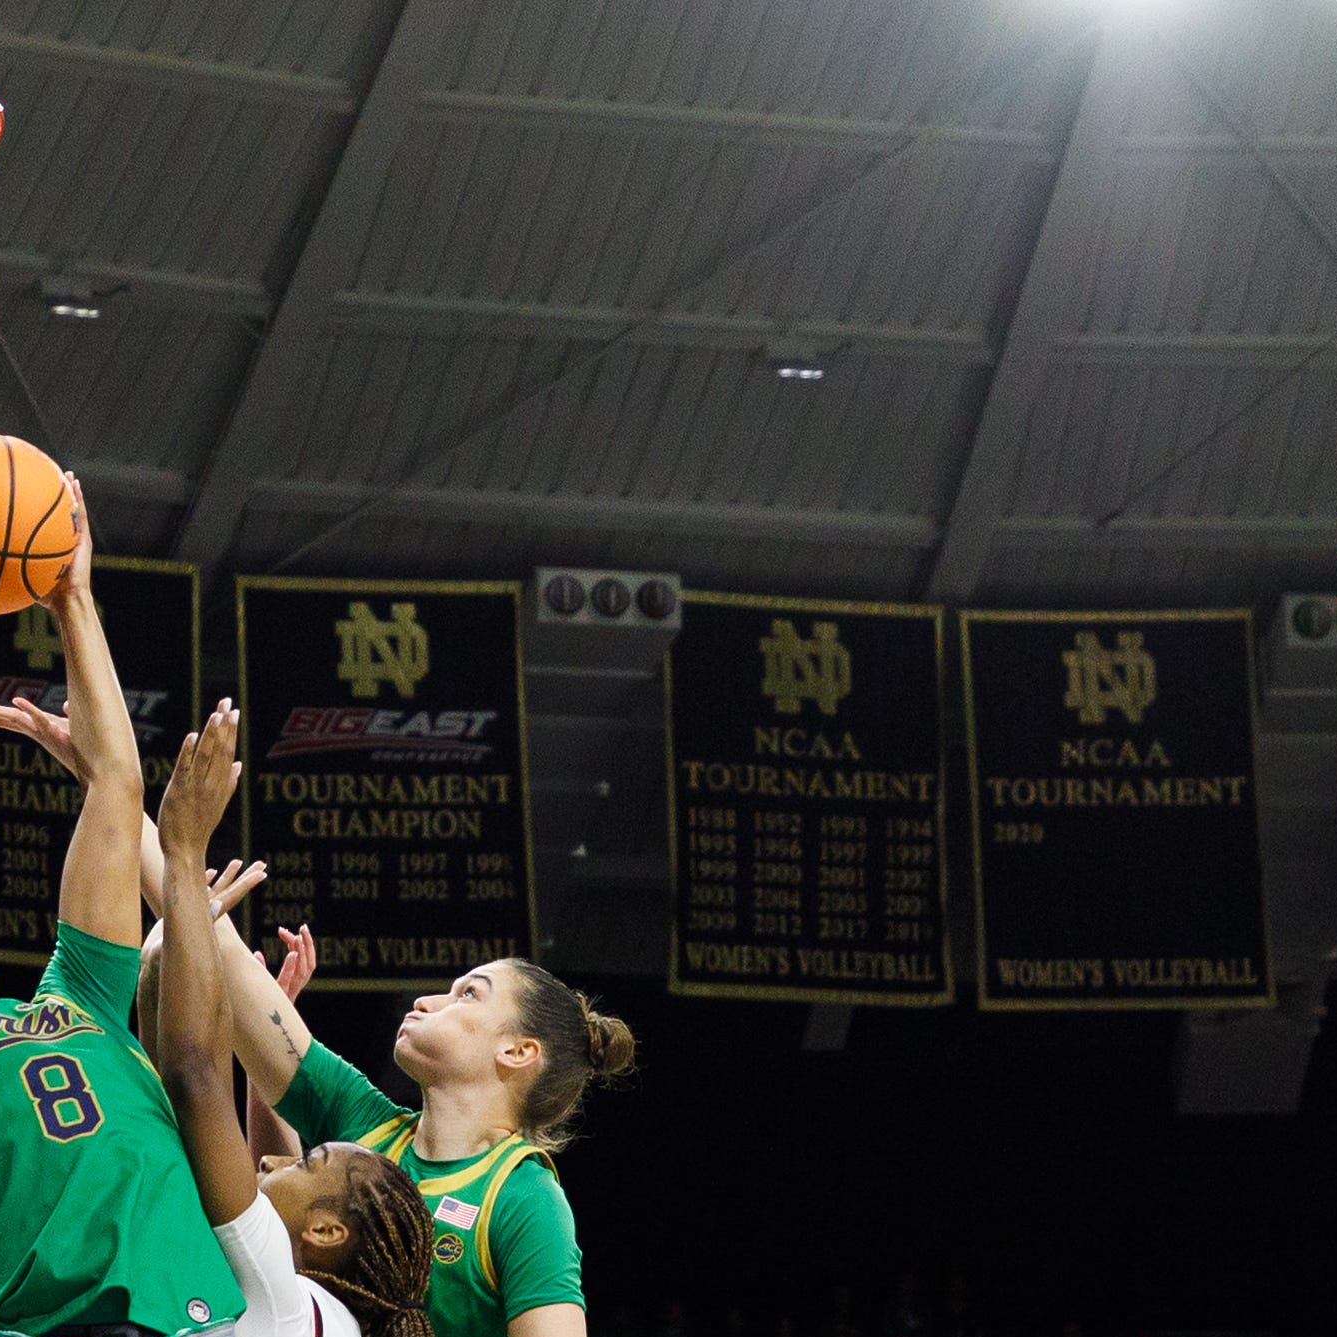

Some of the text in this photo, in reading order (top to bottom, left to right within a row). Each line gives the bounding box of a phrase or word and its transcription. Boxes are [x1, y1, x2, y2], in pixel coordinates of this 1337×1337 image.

[754, 726, 861, 760] NCAA
[1060, 738, 1171, 768] NCAA
[258, 772, 511, 804] TOURNAMENT
[683, 760, 935, 802] TOURNAMENT
[986, 776, 1247, 807] TOURNAMENT
[2, 822, 50, 846] 1996
[293, 808, 482, 838] CHAMPION
[2, 848, 49, 873] 2001
[330, 853, 380, 874] 1996
[399, 853, 448, 874] 1997
[330, 879, 379, 900] 2001
[261, 937, 516, 967] WEN'S VOLLEYBALL
[685, 942, 936, 982] WOMEN'S VOLLEYBALL
[997, 957, 1257, 988] WOMEN'S VOLLEYBALL
[20, 1052, 105, 1143] 8
